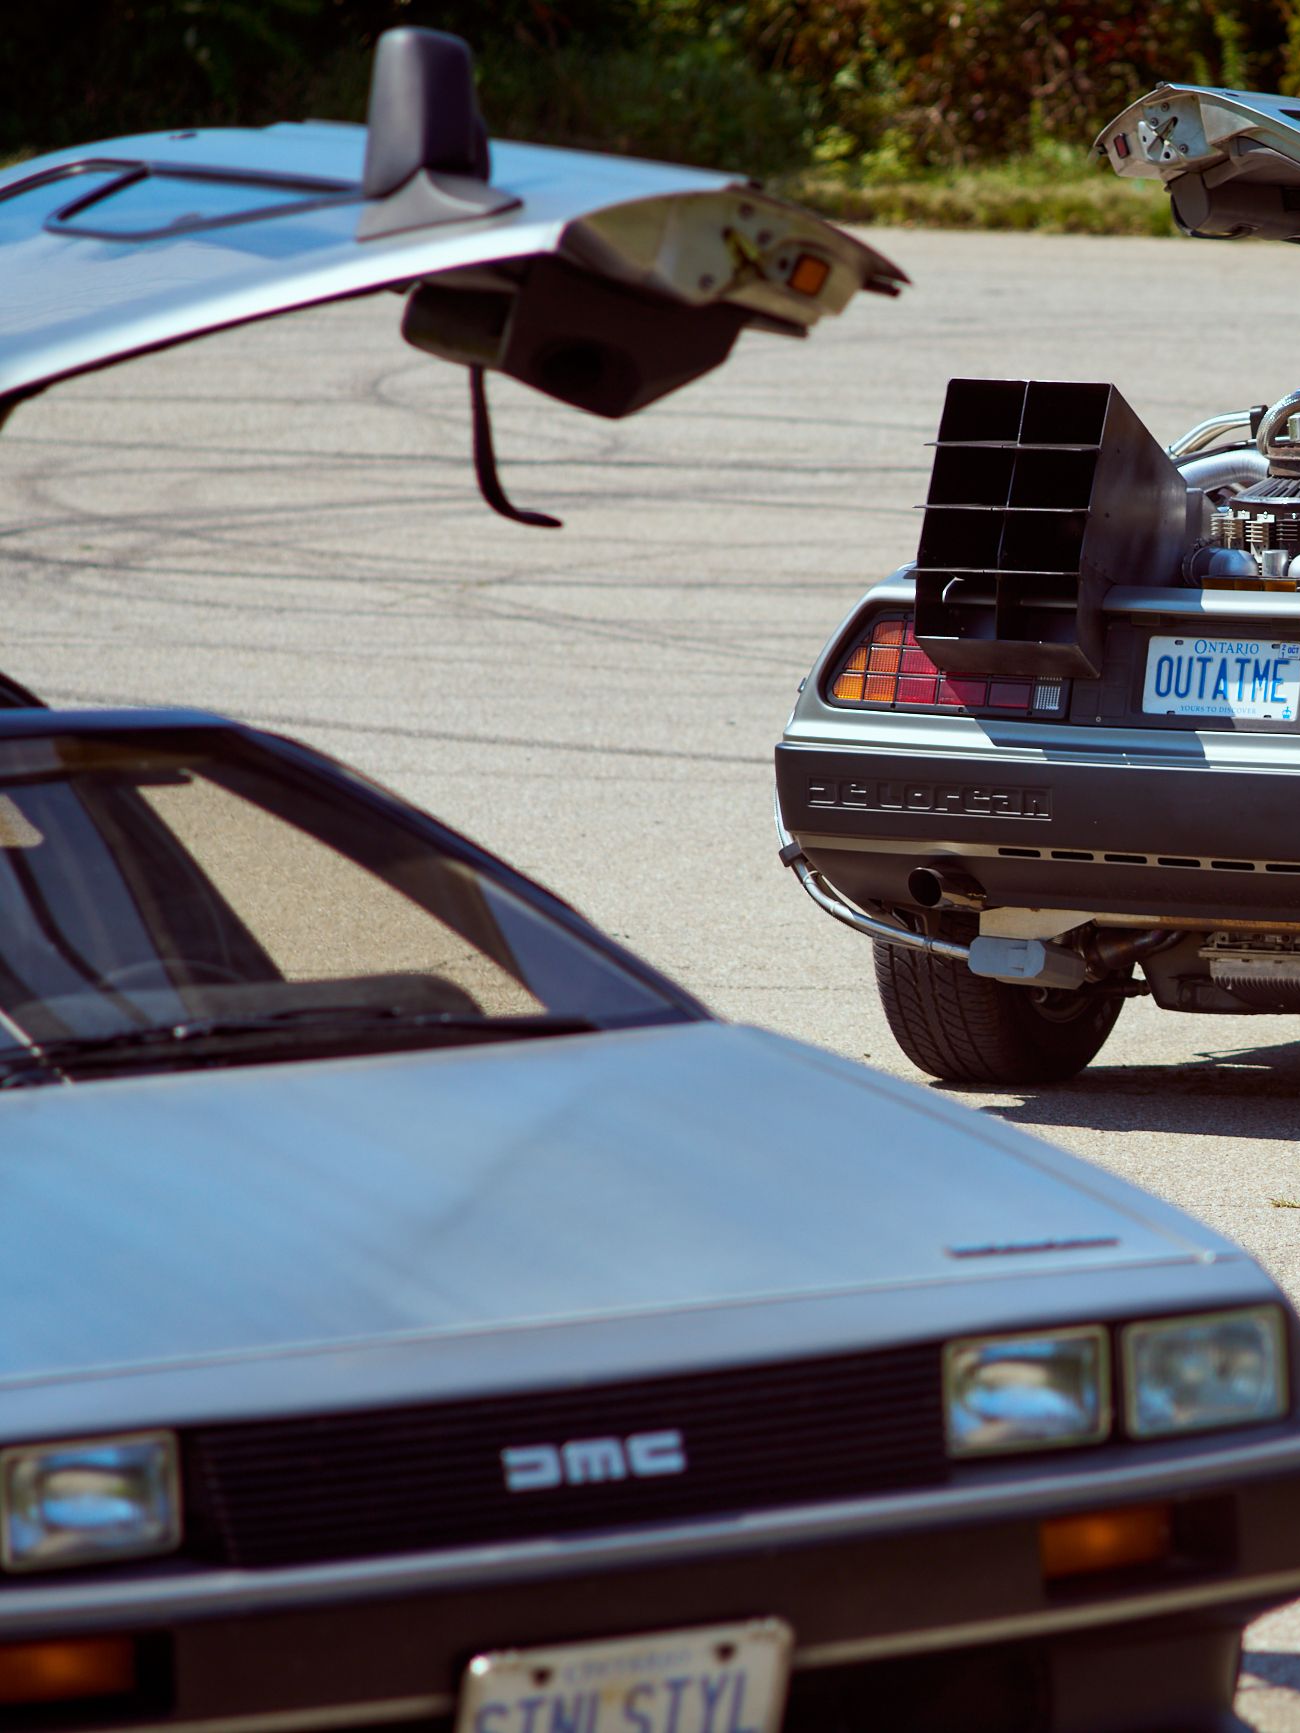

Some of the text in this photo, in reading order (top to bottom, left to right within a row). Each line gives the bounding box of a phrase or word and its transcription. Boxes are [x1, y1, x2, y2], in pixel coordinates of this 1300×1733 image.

[1194, 639, 1260, 656] ONTARIO
[1287, 646, 1300, 655] OCT
[1155, 655, 1290, 703] OUTATME
[1180, 705, 1205, 713] YOURS
[1219, 706, 1257, 714] DISCOVER
